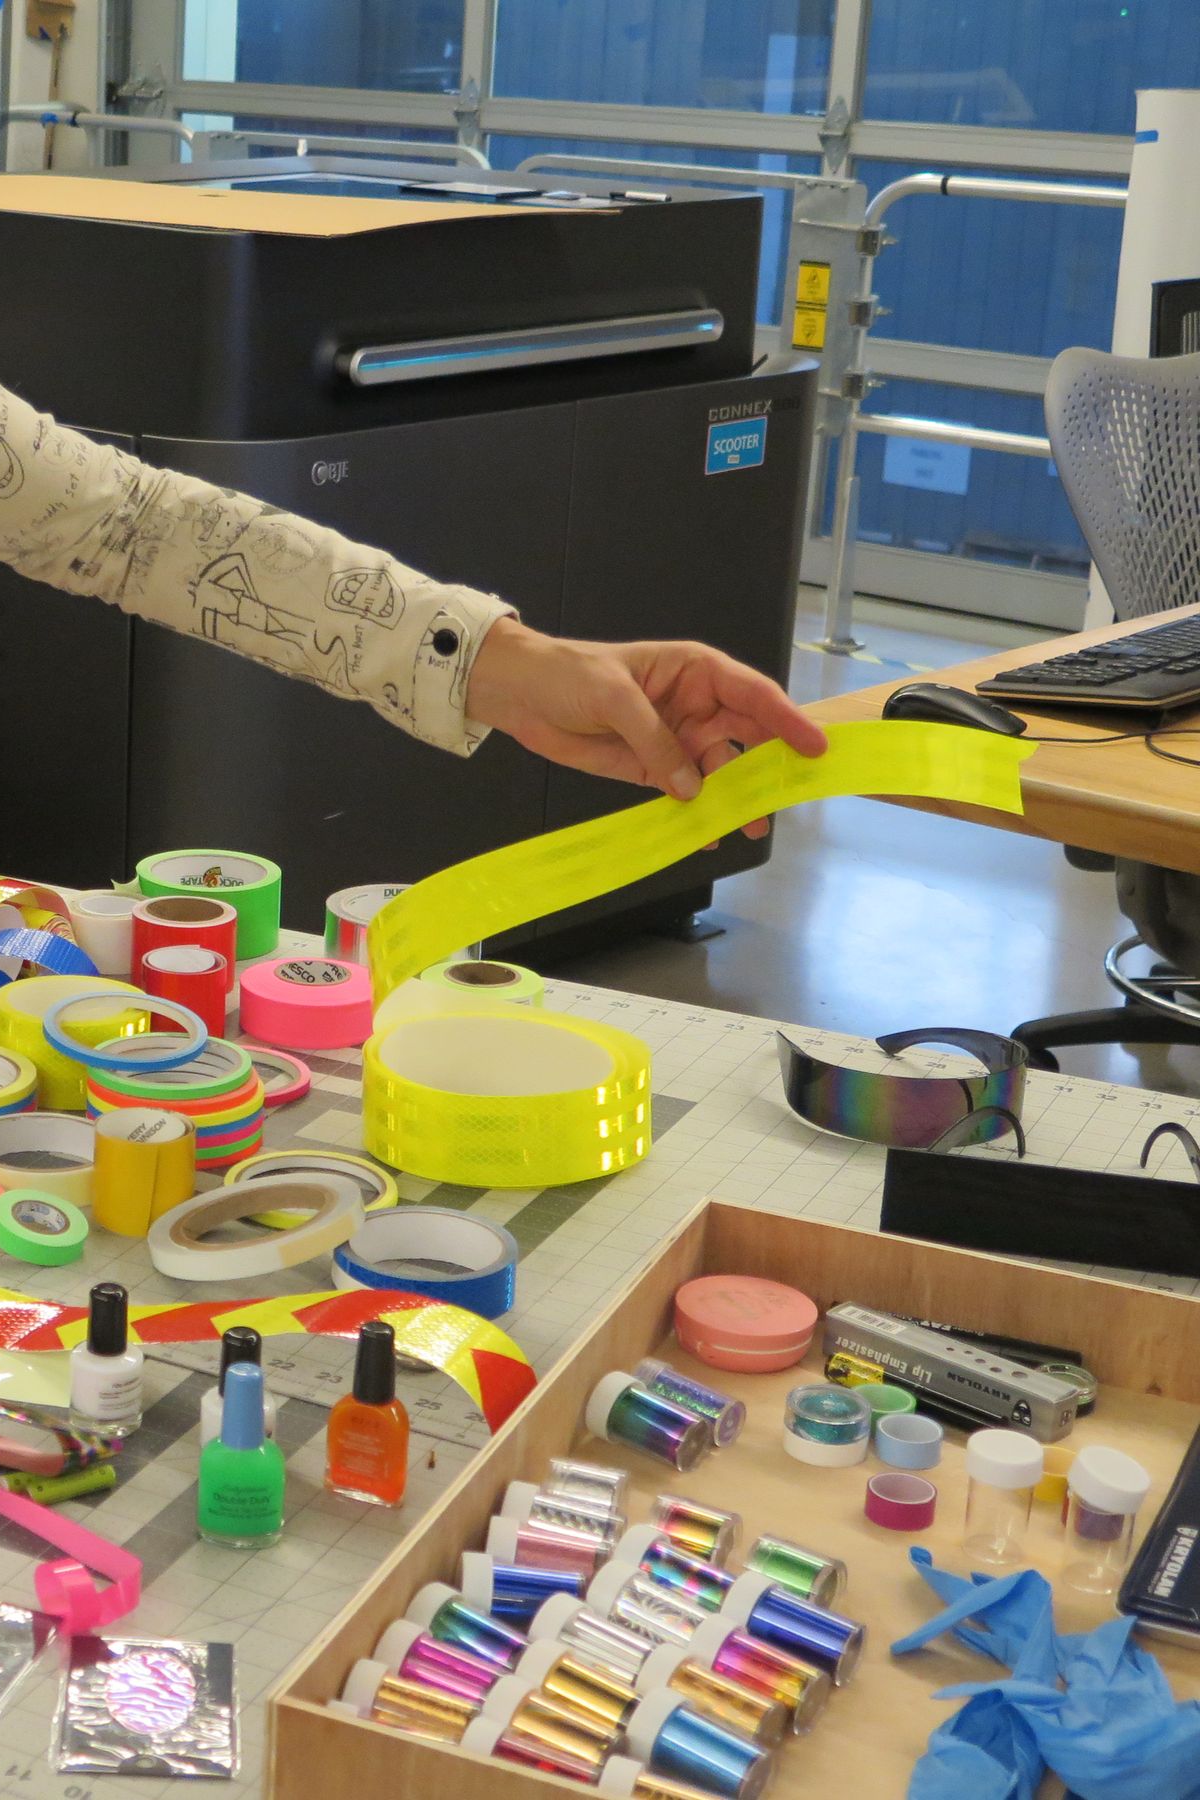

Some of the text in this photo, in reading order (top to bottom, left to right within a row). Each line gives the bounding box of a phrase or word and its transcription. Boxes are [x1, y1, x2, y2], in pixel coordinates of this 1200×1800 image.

[713, 434, 760, 455] SCOOTER
[180, 876, 203, 886] TAPE
[608, 1001, 630, 1009] 20
[648, 1008, 668, 1016] 21
[685, 1015, 706, 1023] 22
[723, 1022, 746, 1030] 23
[1052, 1084, 1073, 1093] 31
[1095, 1093, 1118, 1101] 32
[1138, 1101, 1163, 1110] 33
[267, 1358, 296, 1371] 22
[834, 1335, 933, 1384] Lip Emphasizer
[314, 1371, 343, 1384] 23
[947, 1371, 1012, 1401] KRYOLAN
[414, 1398, 444, 1411] 25
[1153, 1536, 1195, 1598] KRYOLAN
[4, 1764, 33, 1781] 11
